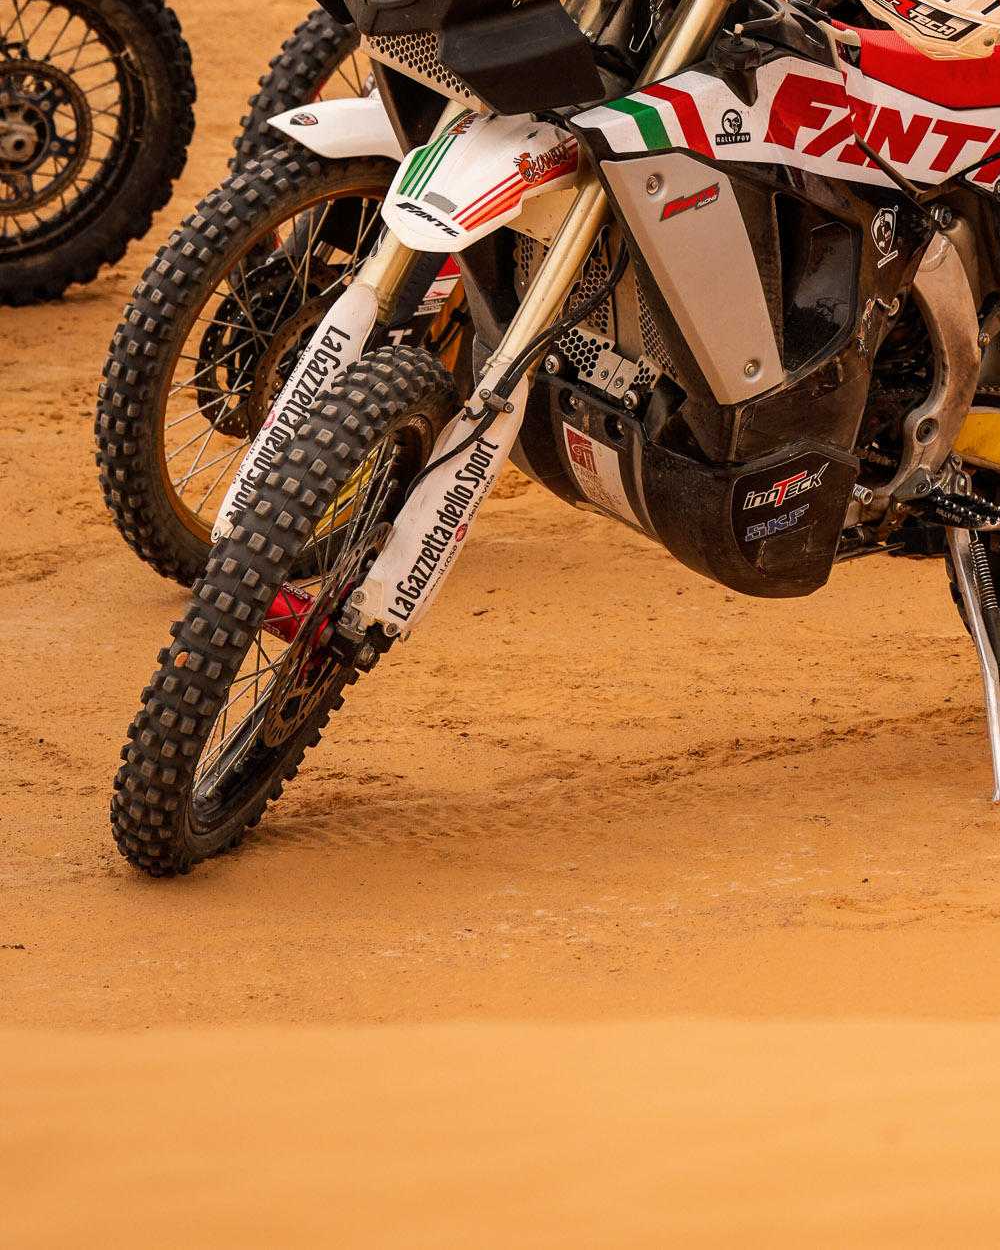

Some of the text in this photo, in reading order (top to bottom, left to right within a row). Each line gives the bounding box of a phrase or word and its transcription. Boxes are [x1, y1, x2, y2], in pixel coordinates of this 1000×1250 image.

[395, 202, 460, 238] FANTIC
[662, 185, 718, 219] FANTIC
[436, 484, 474, 529] dello
[455, 437, 499, 490] Sport
[468, 495, 483, 522] della
[482, 474, 495, 494] vita
[745, 504, 810, 542] SKF
